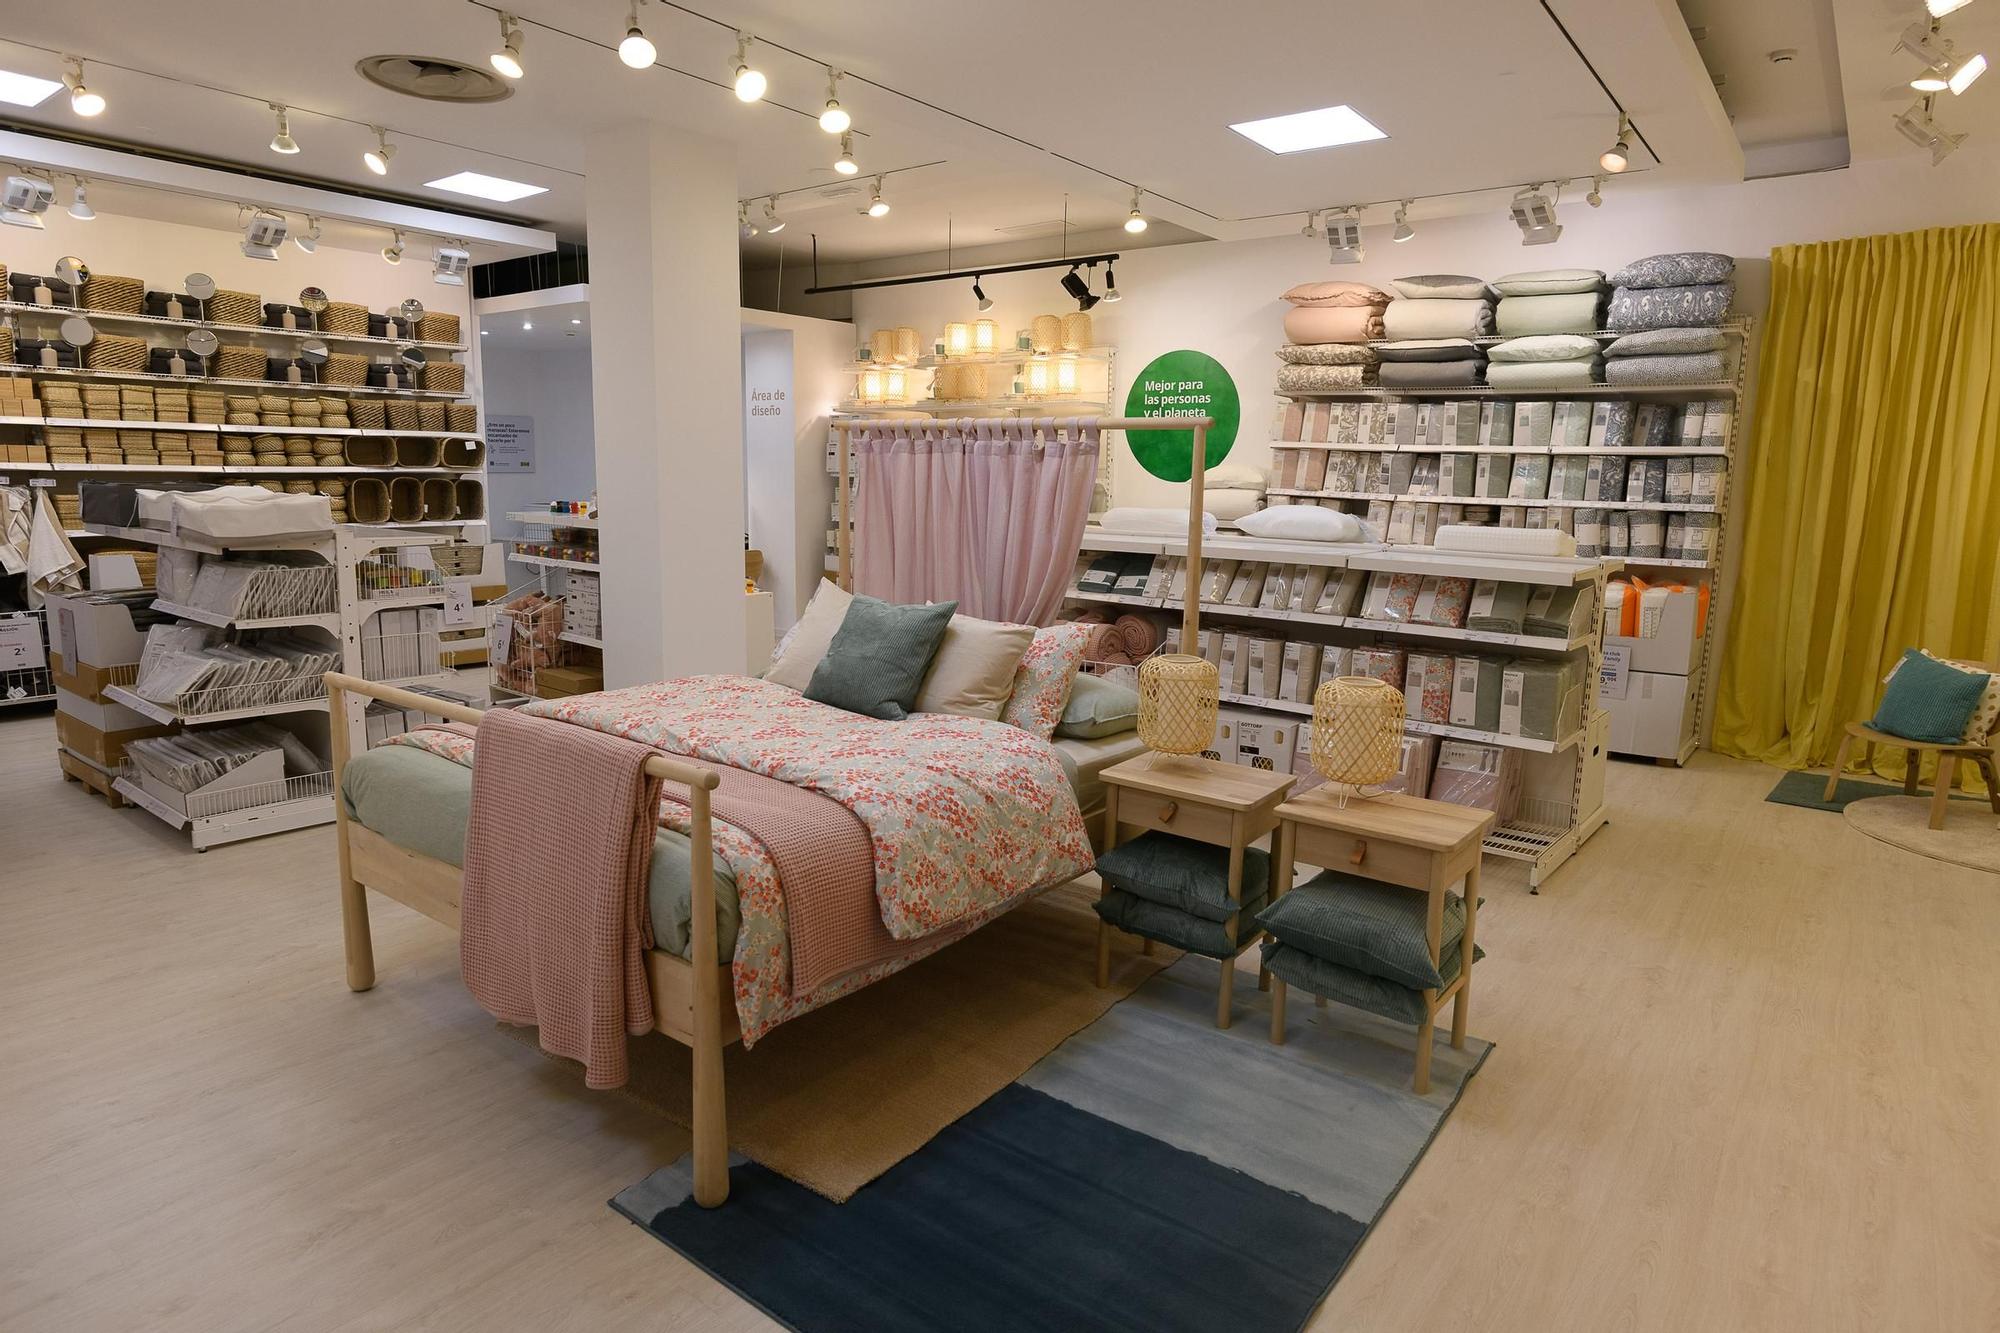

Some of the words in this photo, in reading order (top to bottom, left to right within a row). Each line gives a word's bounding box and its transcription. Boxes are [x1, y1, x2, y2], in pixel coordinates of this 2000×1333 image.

[1145, 380, 1176, 394] Mejor
[1178, 380, 1204, 392] para
[751, 387, 772, 401] Área
[774, 389, 785, 401] de
[1144, 394, 1160, 405] las
[1161, 394, 1212, 407] personas
[751, 404, 781, 416] diseño
[1143, 409, 1151, 418] y
[1152, 407, 1162, 418] el
[1164, 407, 1206, 418] planeta
